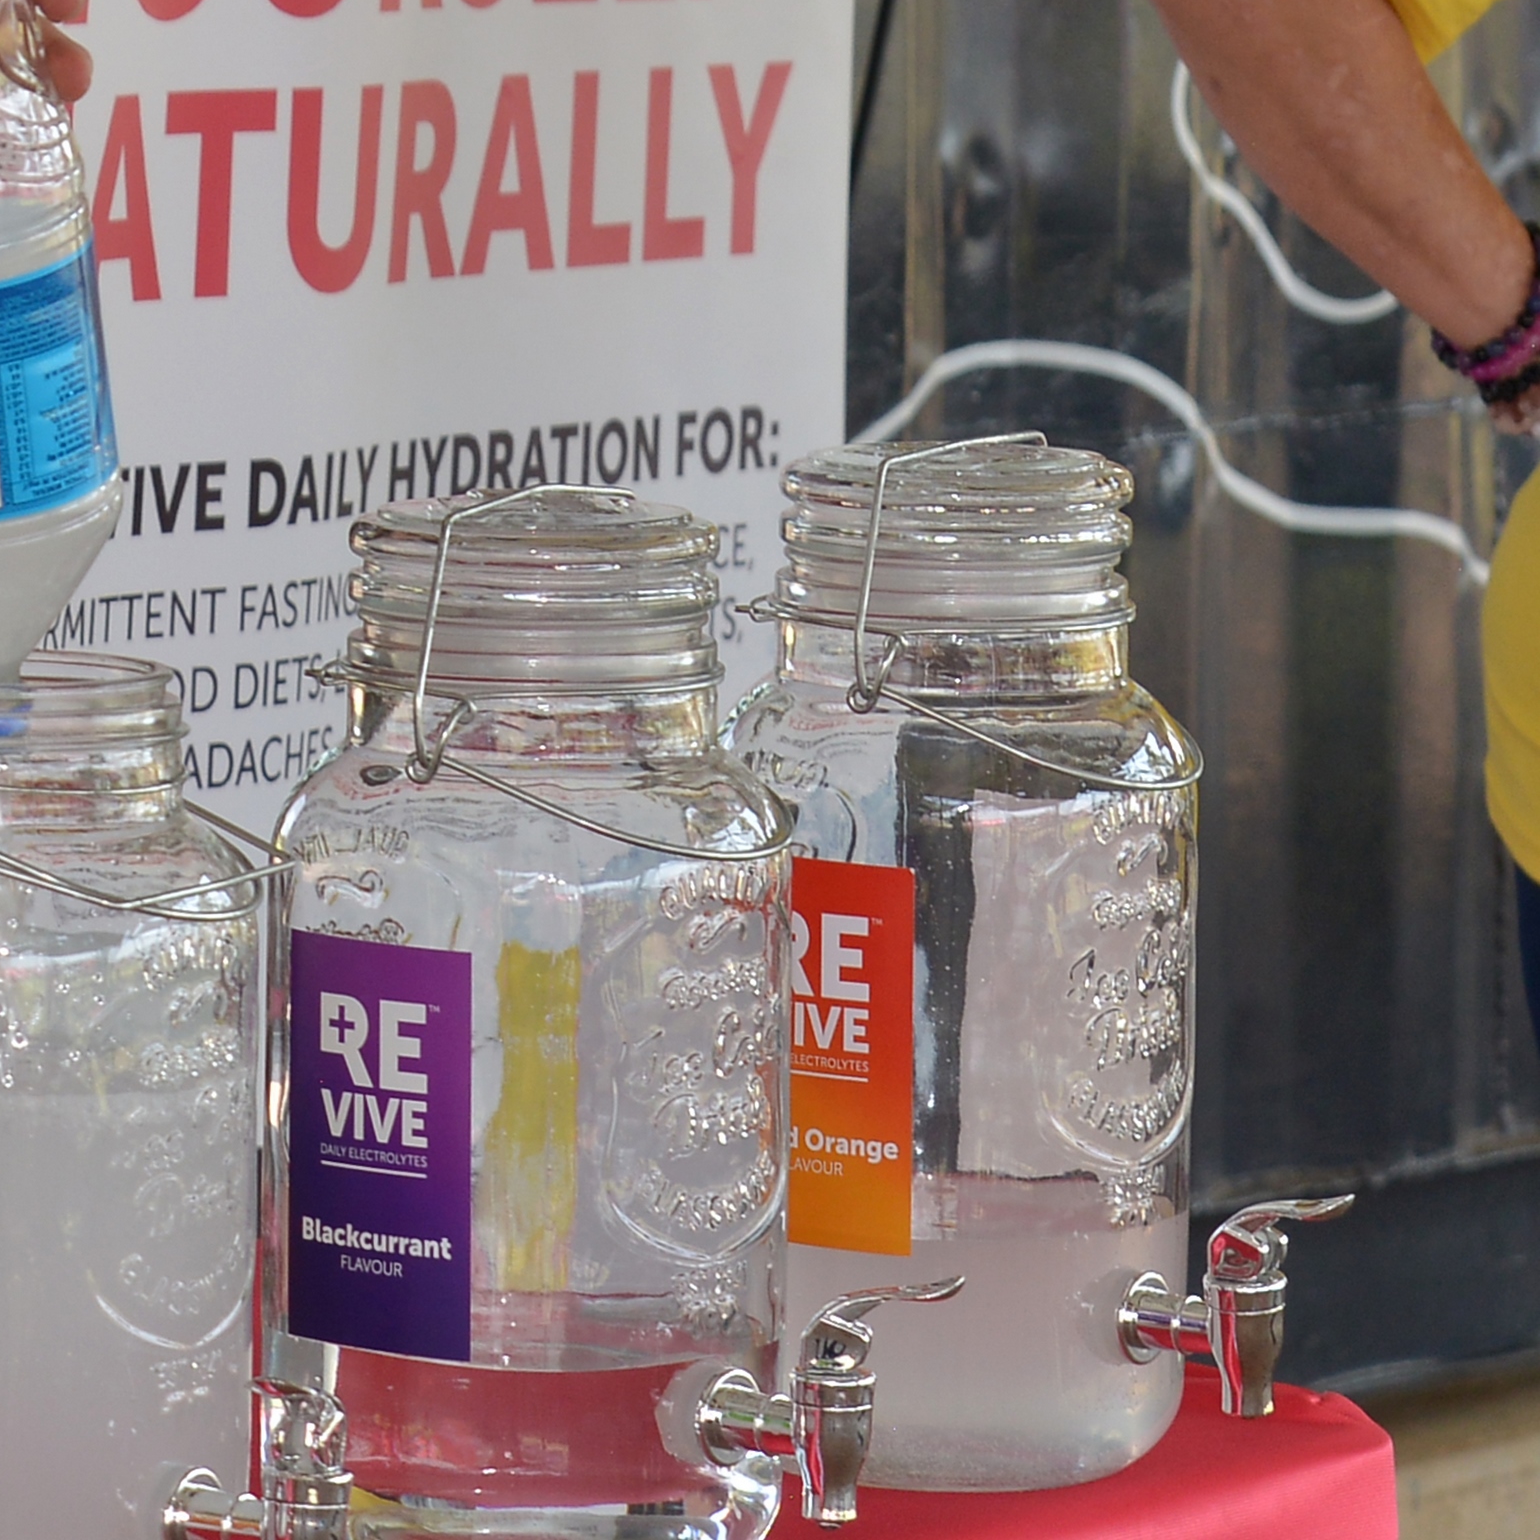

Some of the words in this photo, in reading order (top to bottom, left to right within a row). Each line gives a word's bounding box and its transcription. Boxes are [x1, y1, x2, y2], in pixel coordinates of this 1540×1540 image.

[70, 61, 793, 301] ATURALLY
[112, 461, 226, 538] IVE
[248, 445, 378, 528] DAILY
[388, 415, 660, 502] HYDRATION
[676, 405, 780, 476] FOR:
[320, 991, 428, 1094] RE
[793, 1002, 869, 1054] IVE
[321, 1088, 428, 1148] VIVE
[320, 1142, 346, 1157] DAILY
[349, 1147, 428, 1168] ELECTROLYTES
[804, 1128, 899, 1164] Orange
[302, 1216, 452, 1260] Blackcurrant
[340, 1254, 402, 1277] FLAVOUR
